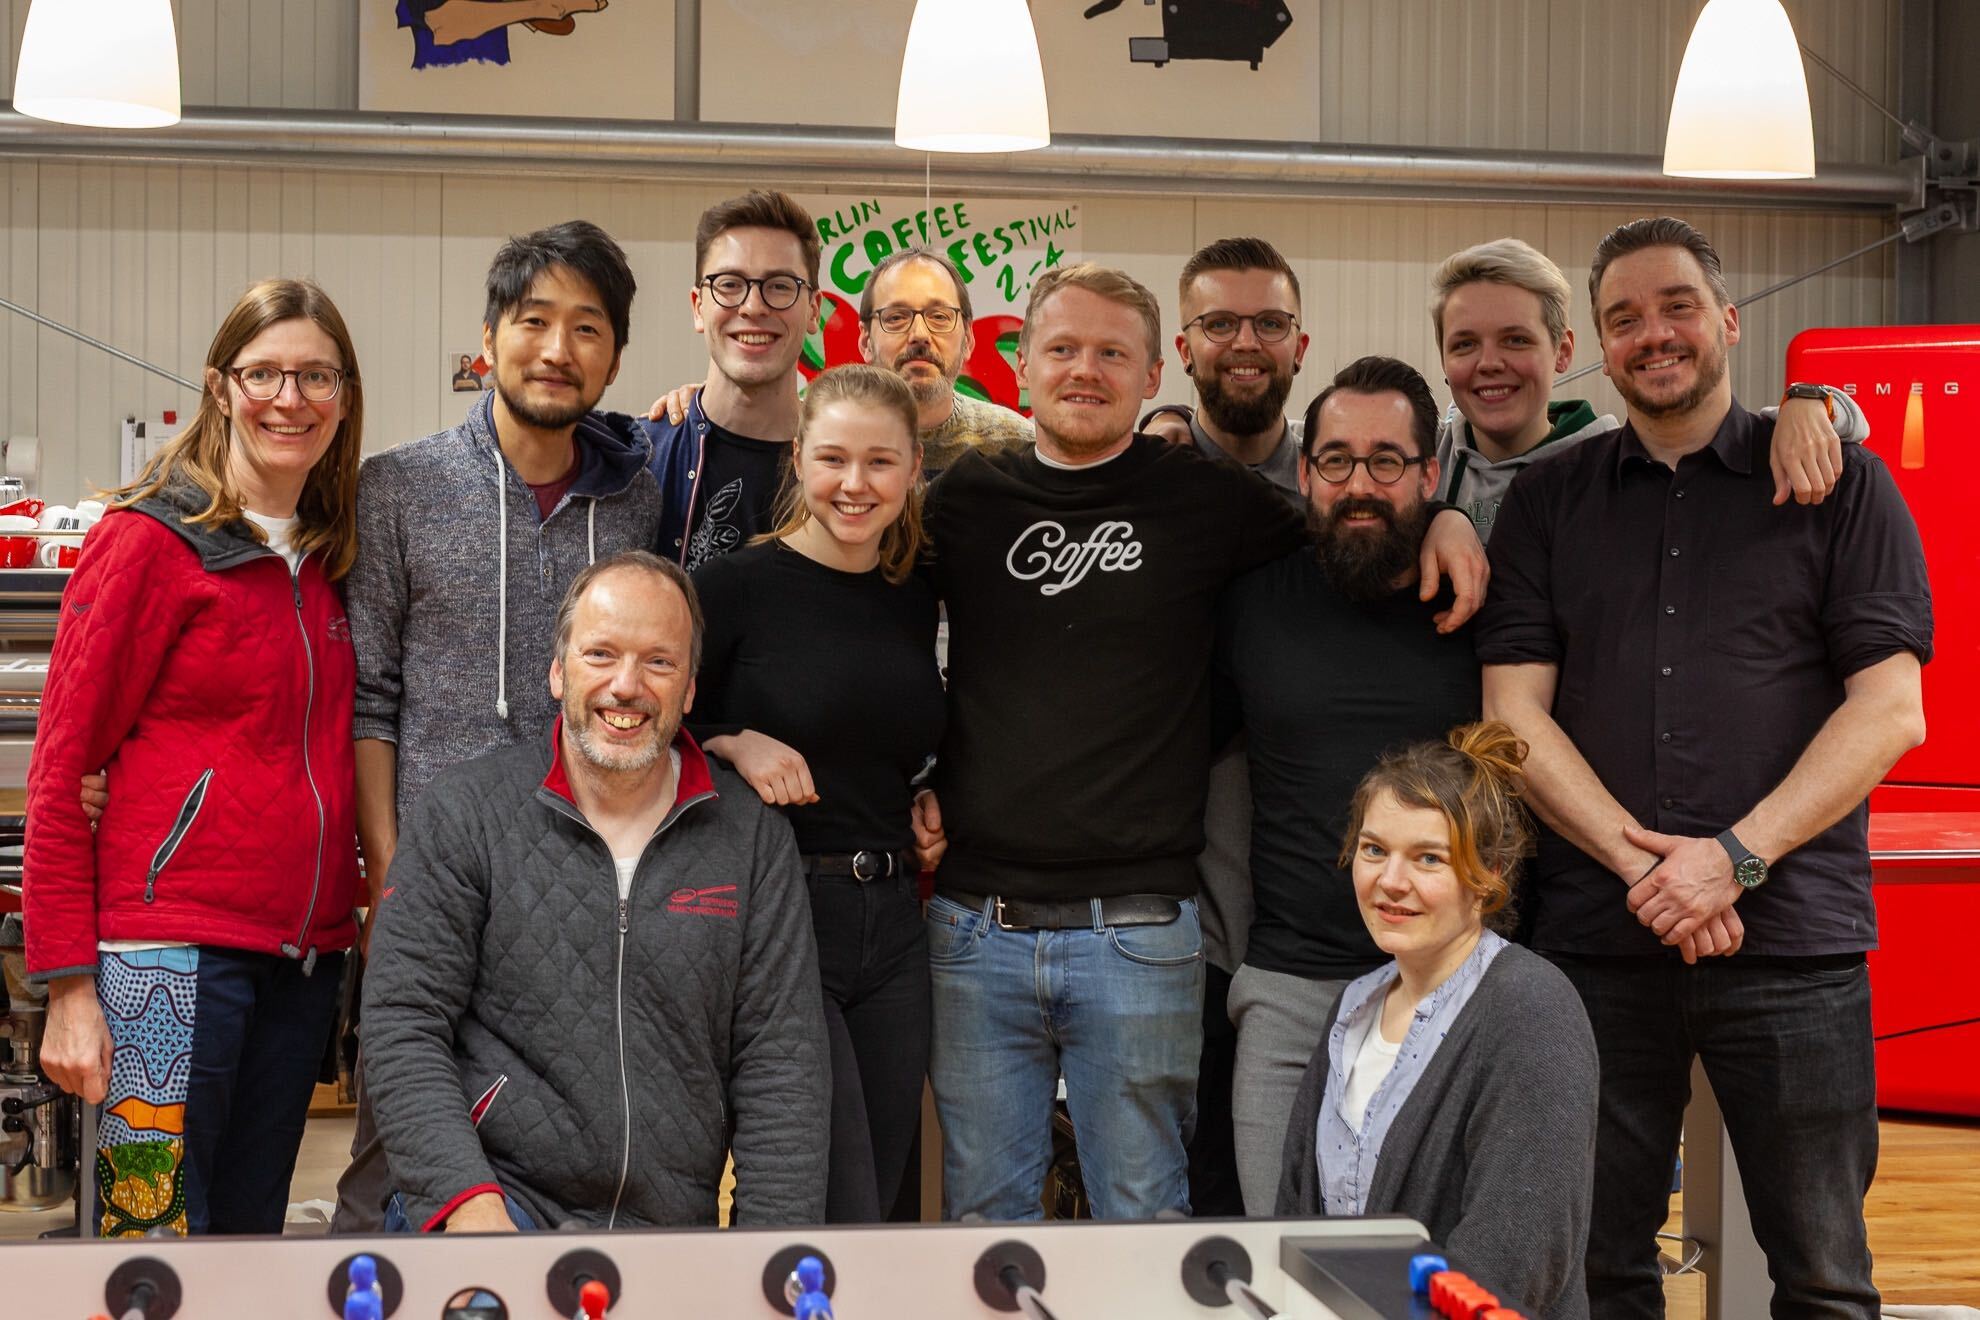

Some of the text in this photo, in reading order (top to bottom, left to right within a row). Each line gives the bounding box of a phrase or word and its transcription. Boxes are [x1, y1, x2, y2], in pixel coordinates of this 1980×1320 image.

[817, 199, 881, 246] RLIN
[830, 202, 971, 294] COFFEE
[946, 208, 1076, 284] FESTIVAL
[1843, 381, 1959, 396] SMEG
[1006, 520, 1142, 596] Coffee
